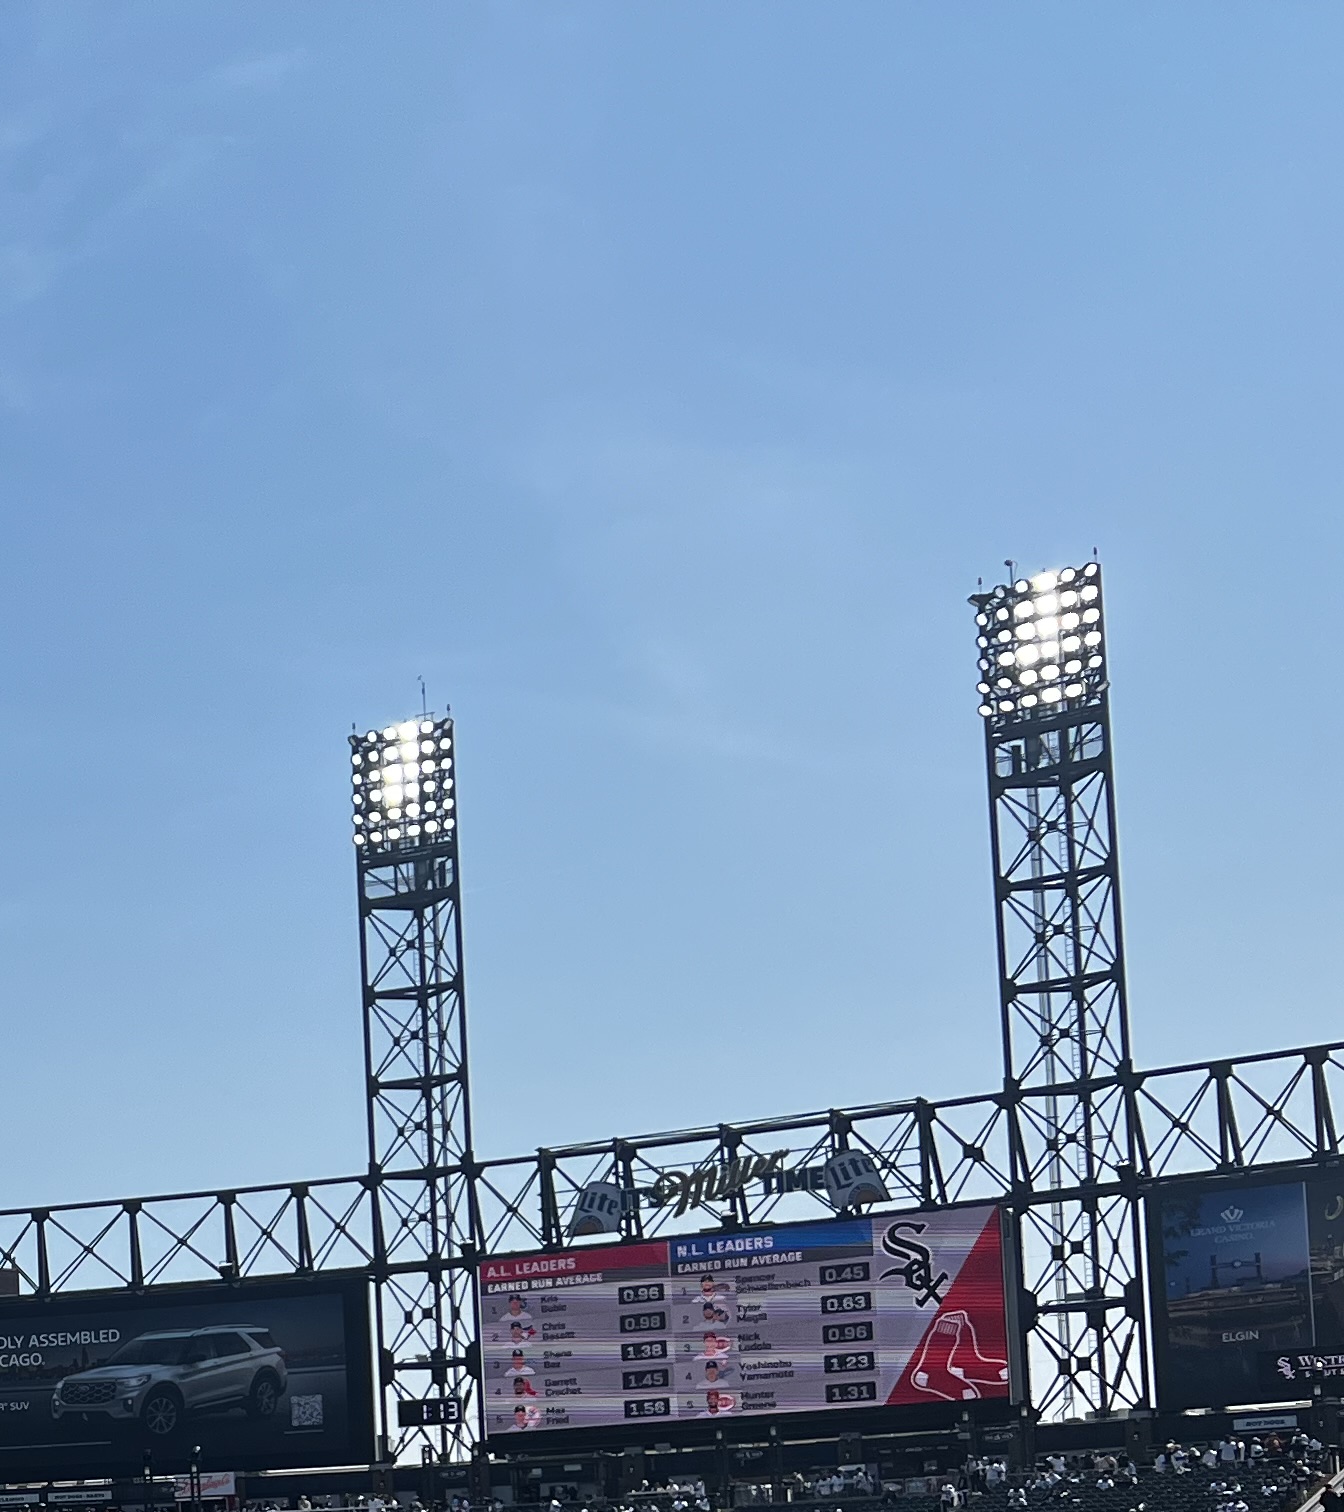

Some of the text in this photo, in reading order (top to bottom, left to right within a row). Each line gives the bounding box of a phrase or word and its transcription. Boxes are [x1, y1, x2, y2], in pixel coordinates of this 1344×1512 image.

[763, 1166, 824, 1195] TIME
[828, 1156, 875, 1190] Lite
[651, 1149, 789, 1218] Miller
[579, 1191, 618, 1215] Lite
[677, 1236, 773, 1257] N.L. LEADERS
[487, 1258, 576, 1278] A.L. LEADERS
[678, 1252, 802, 1273] EARNED RUN AVERAGE
[825, 1266, 864, 1281] 0.45
[488, 1273, 602, 1293] EARNED RUN AVERAGE
[623, 1287, 659, 1302] 0.96
[625, 1316, 660, 1330] 0.98
[29, 1329, 120, 1348] ASSEMBLED
[828, 1326, 867, 1341] 0.96
[1222, 1330, 1259, 1343] ELGIN
[627, 1344, 662, 1358] 1.38
[830, 1355, 869, 1370] 1.23
[629, 1373, 663, 1387] 1.45
[832, 1386, 870, 1400] 1.31
[10, 1402, 29, 1411] SUV
[422, 1402, 458, 1420] 1:13
